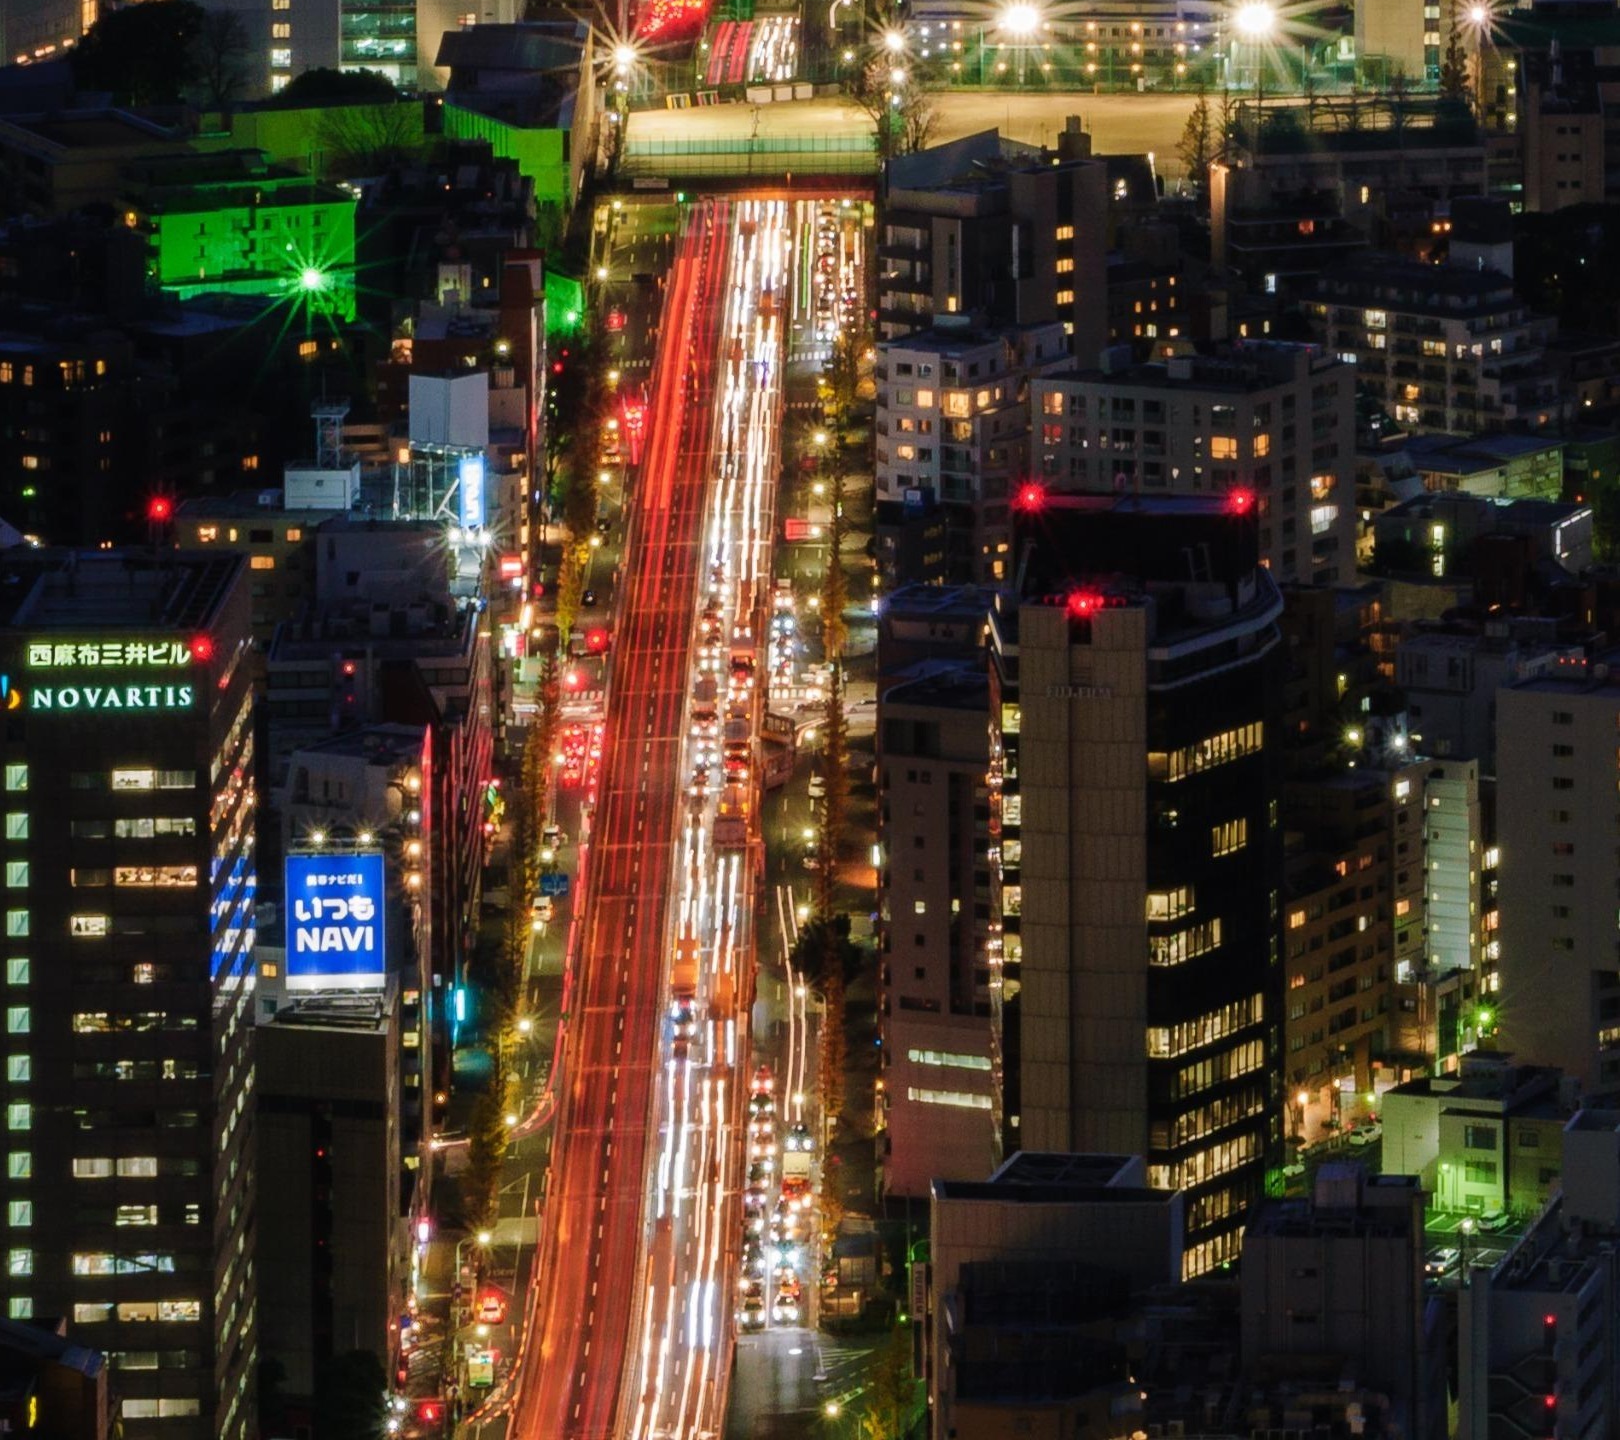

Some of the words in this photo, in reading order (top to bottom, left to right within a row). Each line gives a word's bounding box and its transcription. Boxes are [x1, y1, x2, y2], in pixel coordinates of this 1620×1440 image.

[29, 642, 192, 666] 西麻布三井ビル
[32, 686, 192, 709] NOVARTIS
[295, 895, 375, 922] いつも
[296, 926, 374, 952] NAVI
